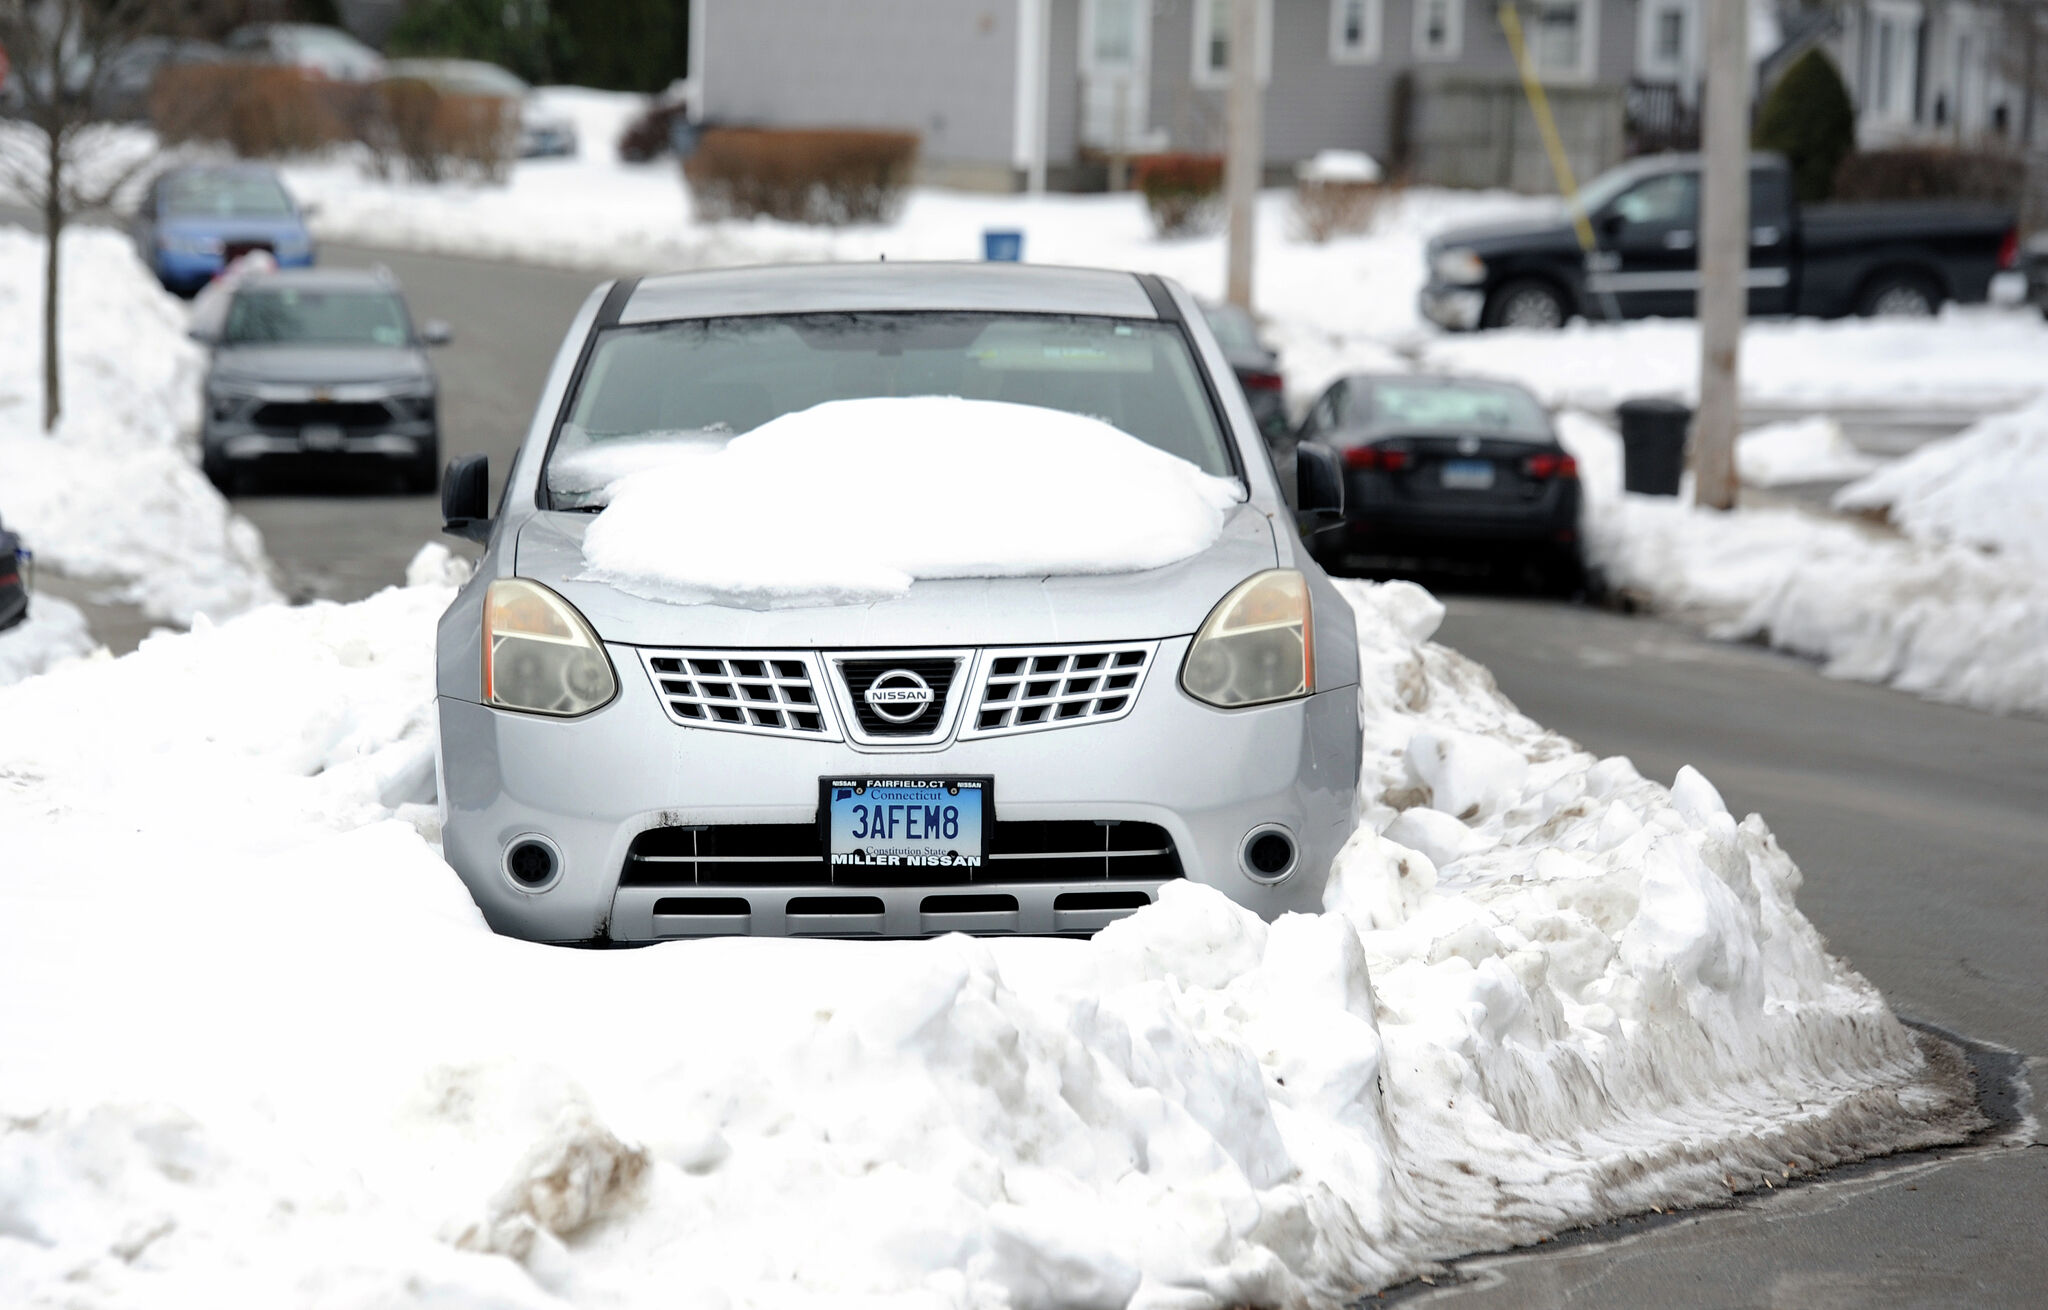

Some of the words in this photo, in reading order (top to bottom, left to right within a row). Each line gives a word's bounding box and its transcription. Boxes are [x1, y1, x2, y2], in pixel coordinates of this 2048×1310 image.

[872, 691, 927, 701] NISSAN
[871, 790, 941, 801] Connecticut
[852, 805, 959, 839] 3AFEM8
[865, 846, 922, 856] Constitution
[924, 846, 947, 856] State
[831, 854, 901, 866] MILLER
[907, 855, 981, 867] NISSAN
